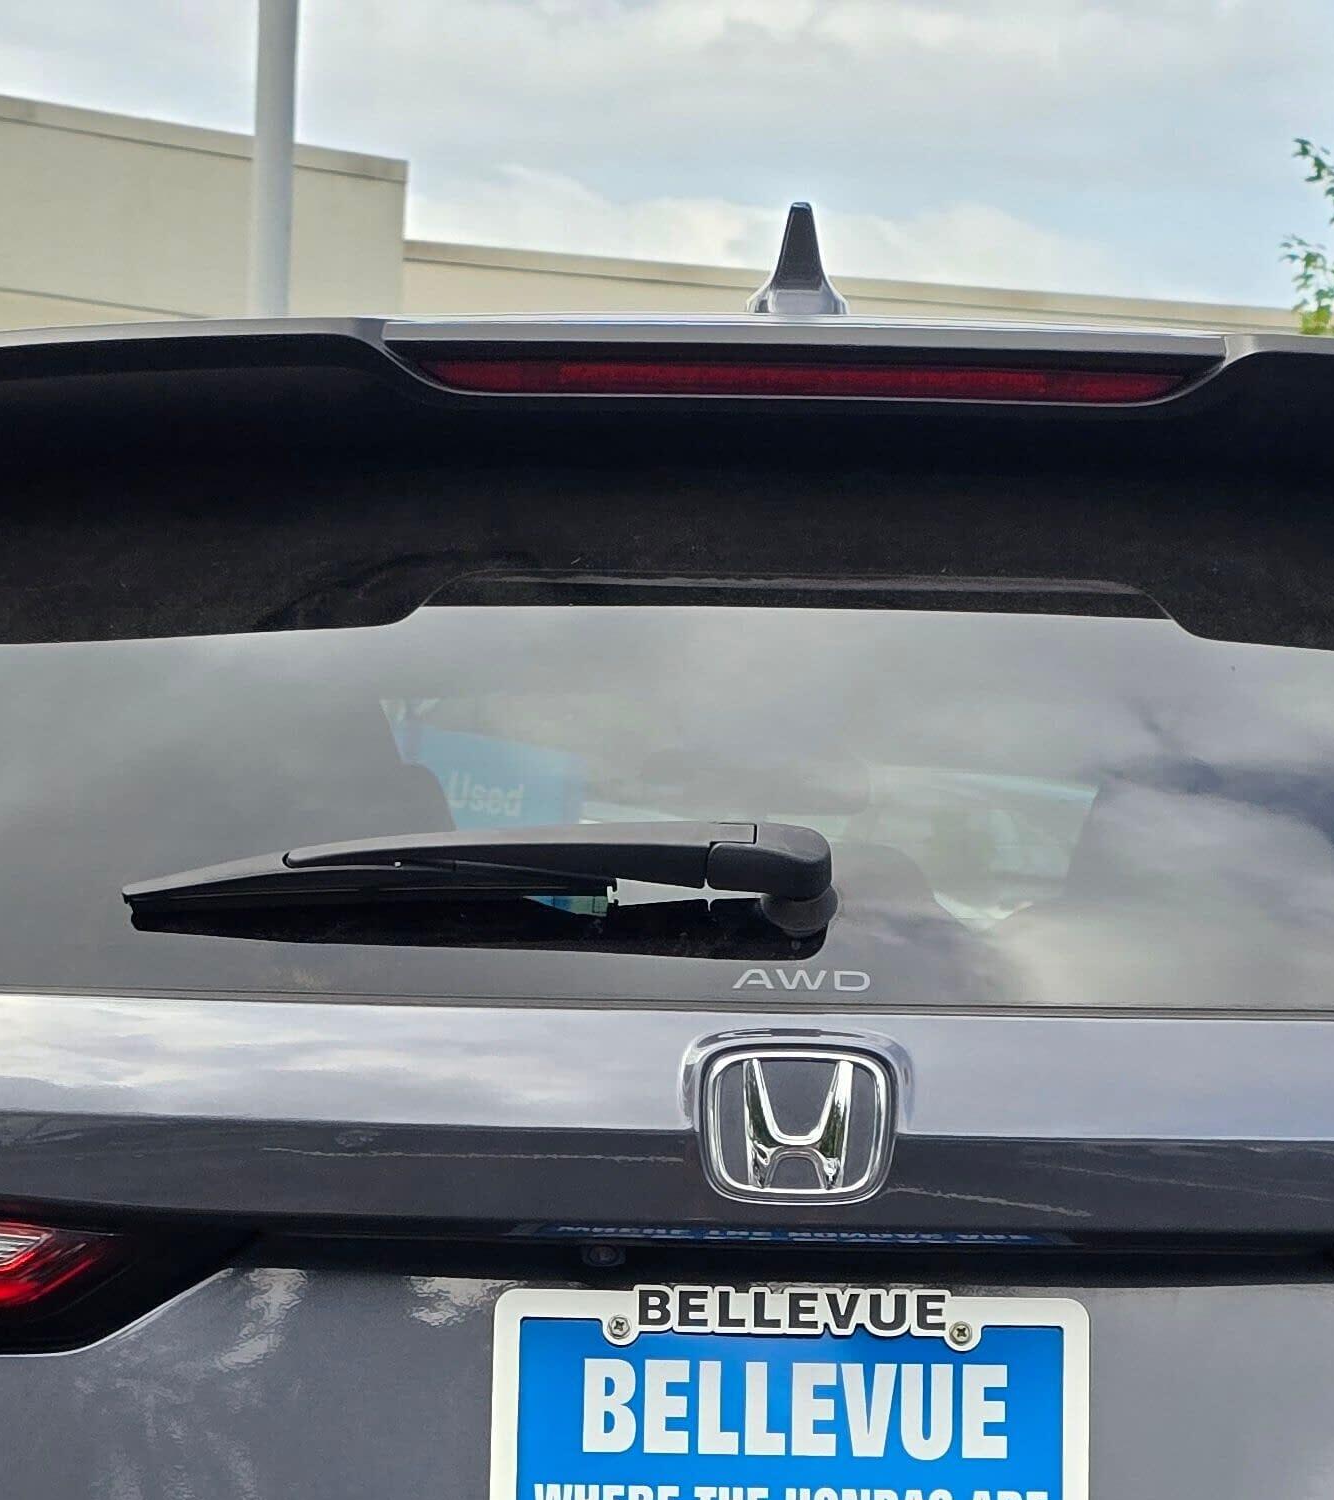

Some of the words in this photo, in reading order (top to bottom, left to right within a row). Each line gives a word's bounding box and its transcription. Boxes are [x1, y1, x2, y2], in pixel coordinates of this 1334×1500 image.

[447, 768, 526, 817] Used
[732, 968, 871, 992] AWD
[637, 1288, 946, 1332] BELLEVUE
[582, 1357, 1008, 1461] BELLEVUE
